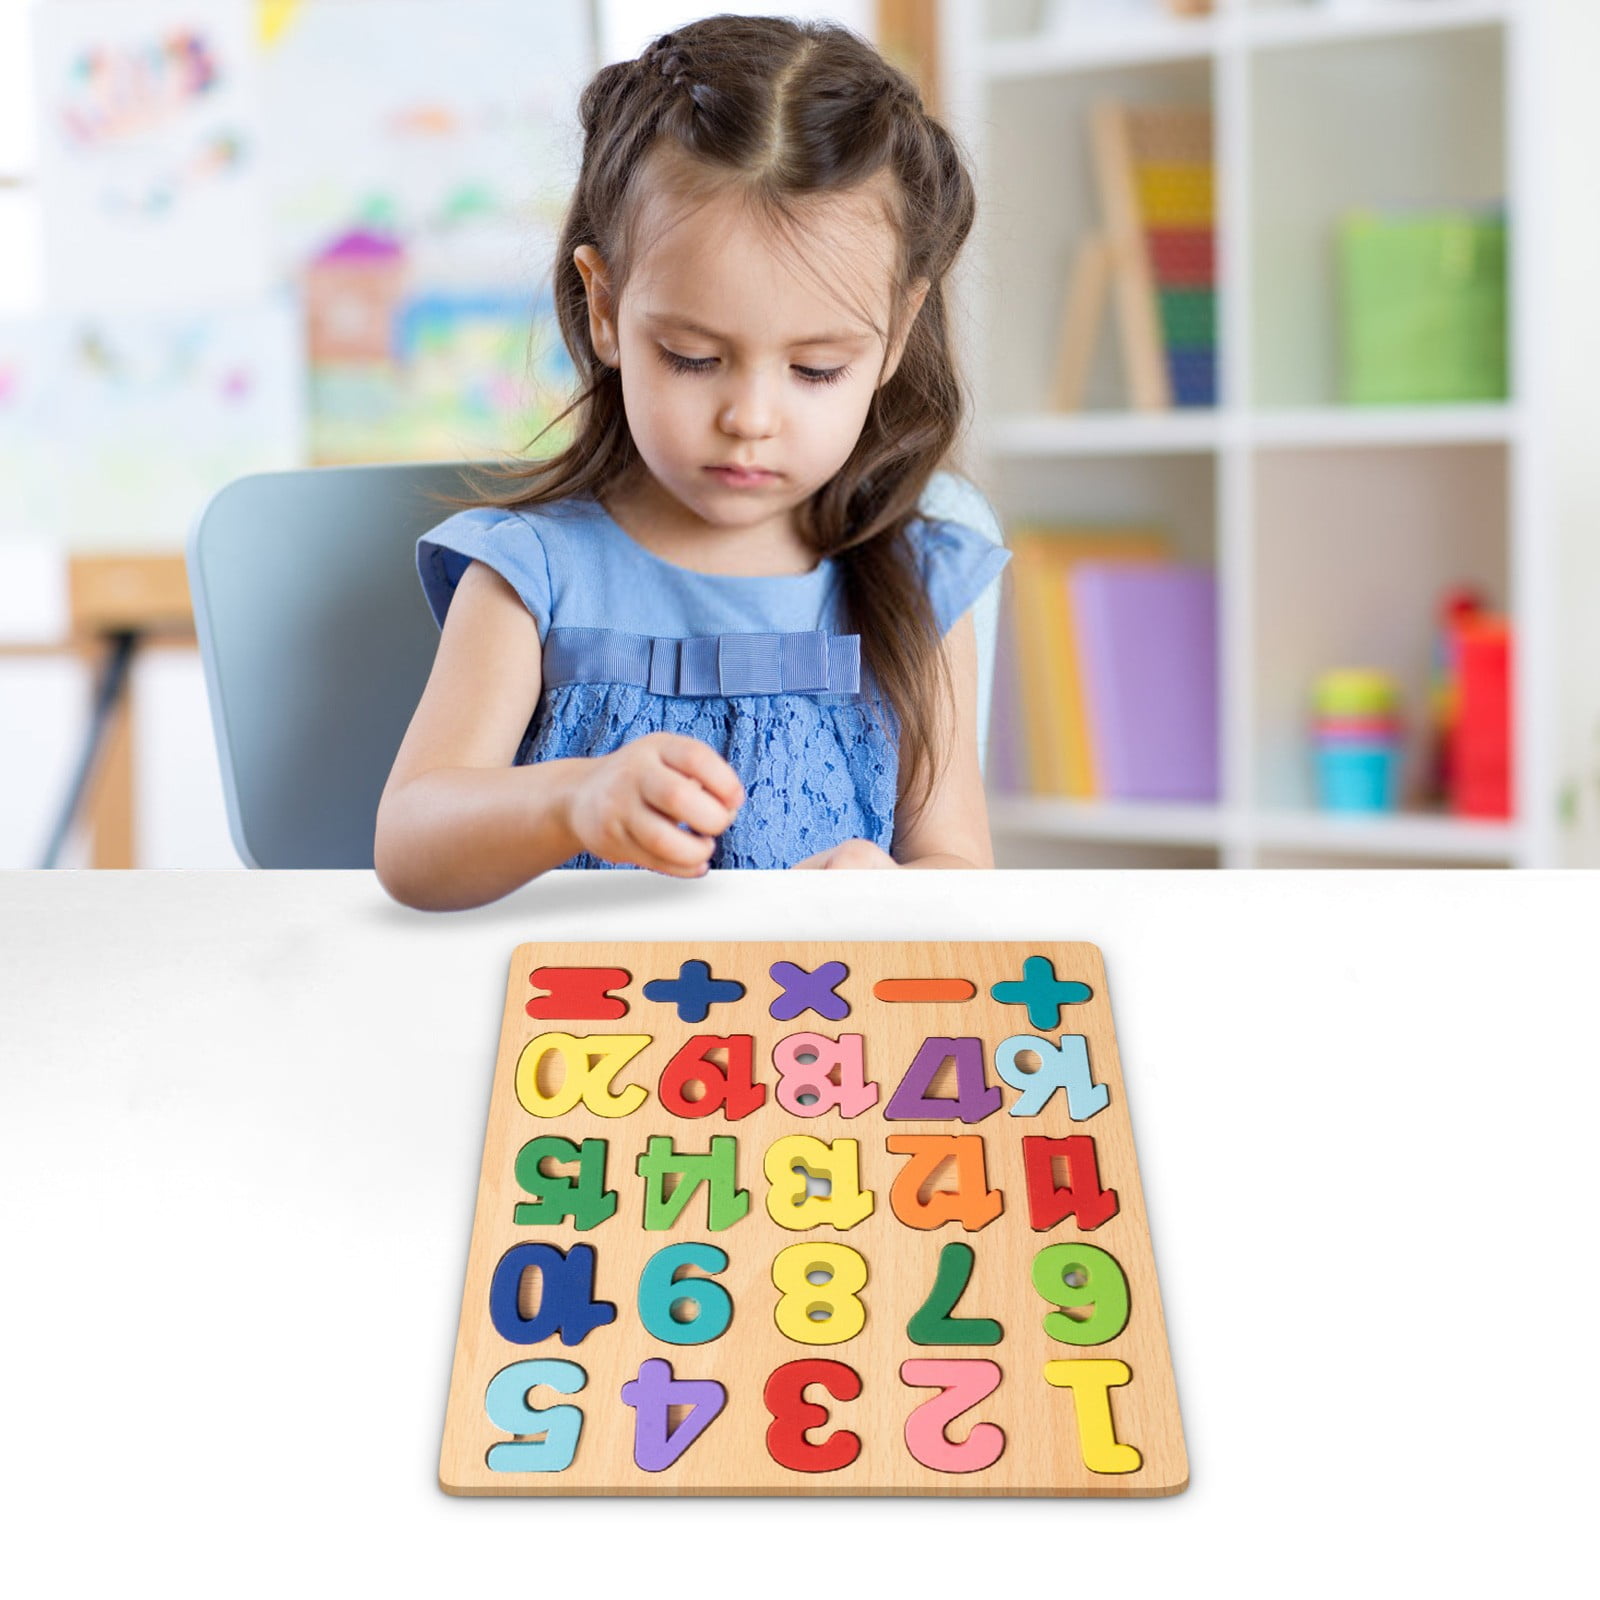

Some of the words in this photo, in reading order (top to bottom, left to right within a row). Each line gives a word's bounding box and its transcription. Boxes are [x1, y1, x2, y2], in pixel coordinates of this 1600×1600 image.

[515, 1032, 653, 1119] 20
[658, 1034, 766, 1121] 19
[773, 1032, 878, 1119] 18
[883, 1036, 1002, 1123] 17
[995, 1034, 1109, 1121] 16
[513, 1135, 618, 1231] 15
[635, 1134, 750, 1231] 14
[764, 1134, 875, 1231] 13
[886, 1134, 1004, 1231] 12
[1023, 1135, 1120, 1231] 11
[489, 1241, 617, 1346] 10
[637, 1242, 733, 1345] 9
[771, 1242, 869, 1345] 8
[907, 1242, 1003, 1346] 7
[1031, 1242, 1131, 1346] 6
[485, 1358, 588, 1473] 5
[621, 1358, 728, 1472] 4
[763, 1358, 862, 1473] 3
[900, 1358, 1006, 1473] 2
[1043, 1359, 1142, 1474] 1
